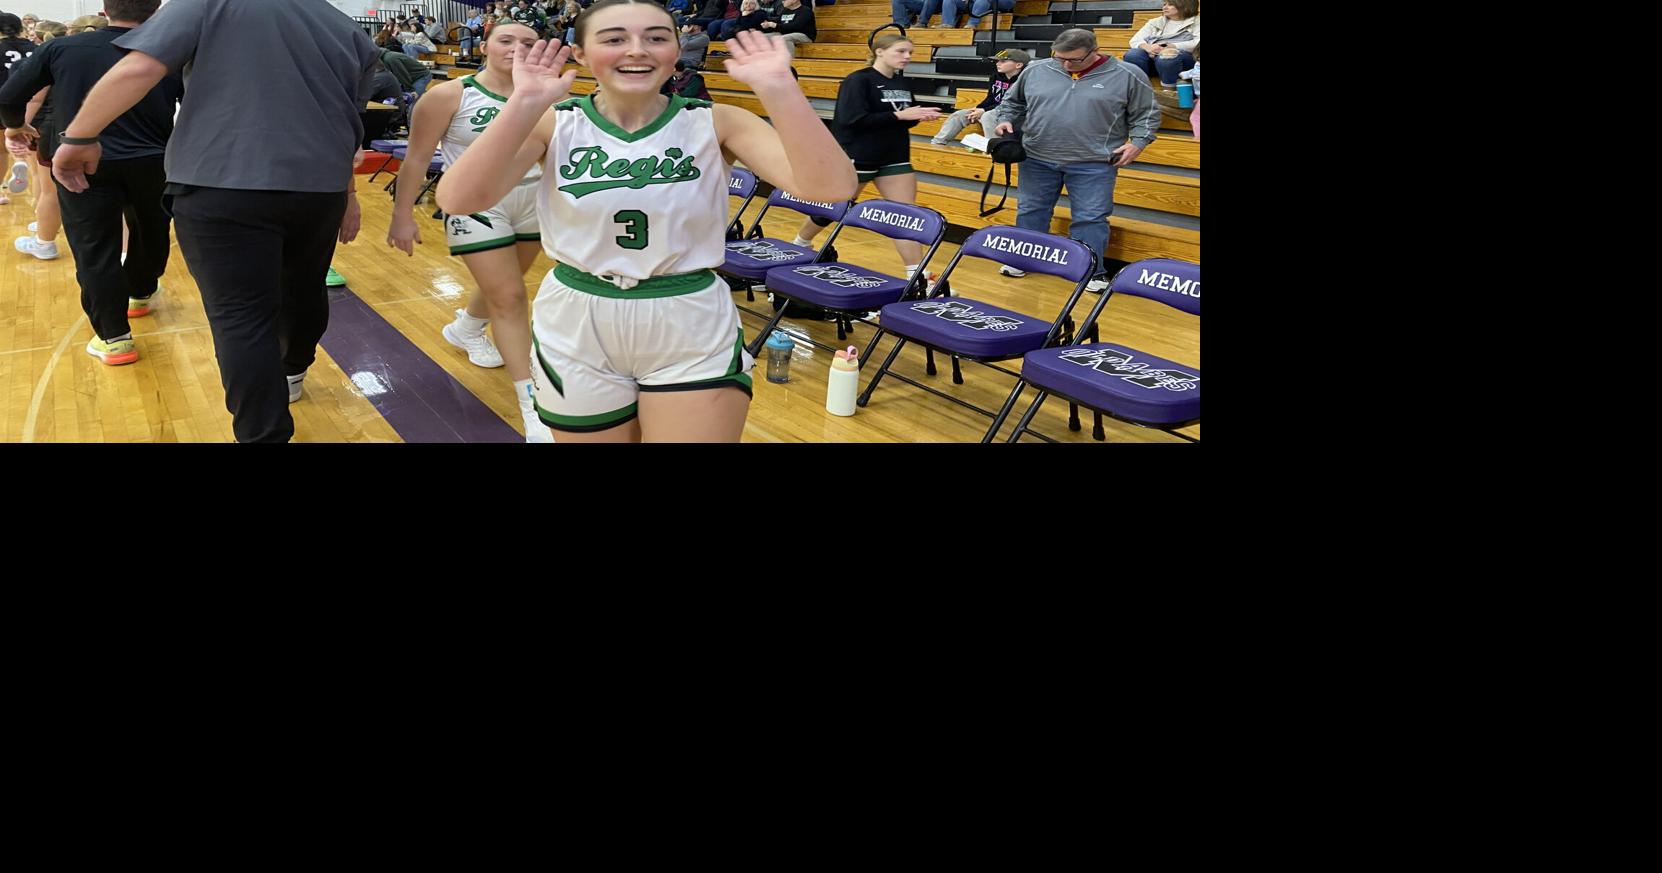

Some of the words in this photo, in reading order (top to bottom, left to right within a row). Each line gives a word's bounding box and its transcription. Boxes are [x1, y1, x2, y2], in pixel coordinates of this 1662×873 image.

[559, 146, 701, 190] Regis
[613, 209, 649, 250] 3
[859, 206, 926, 232] MEMORIAL
[982, 233, 1068, 265] MEMORIAL
